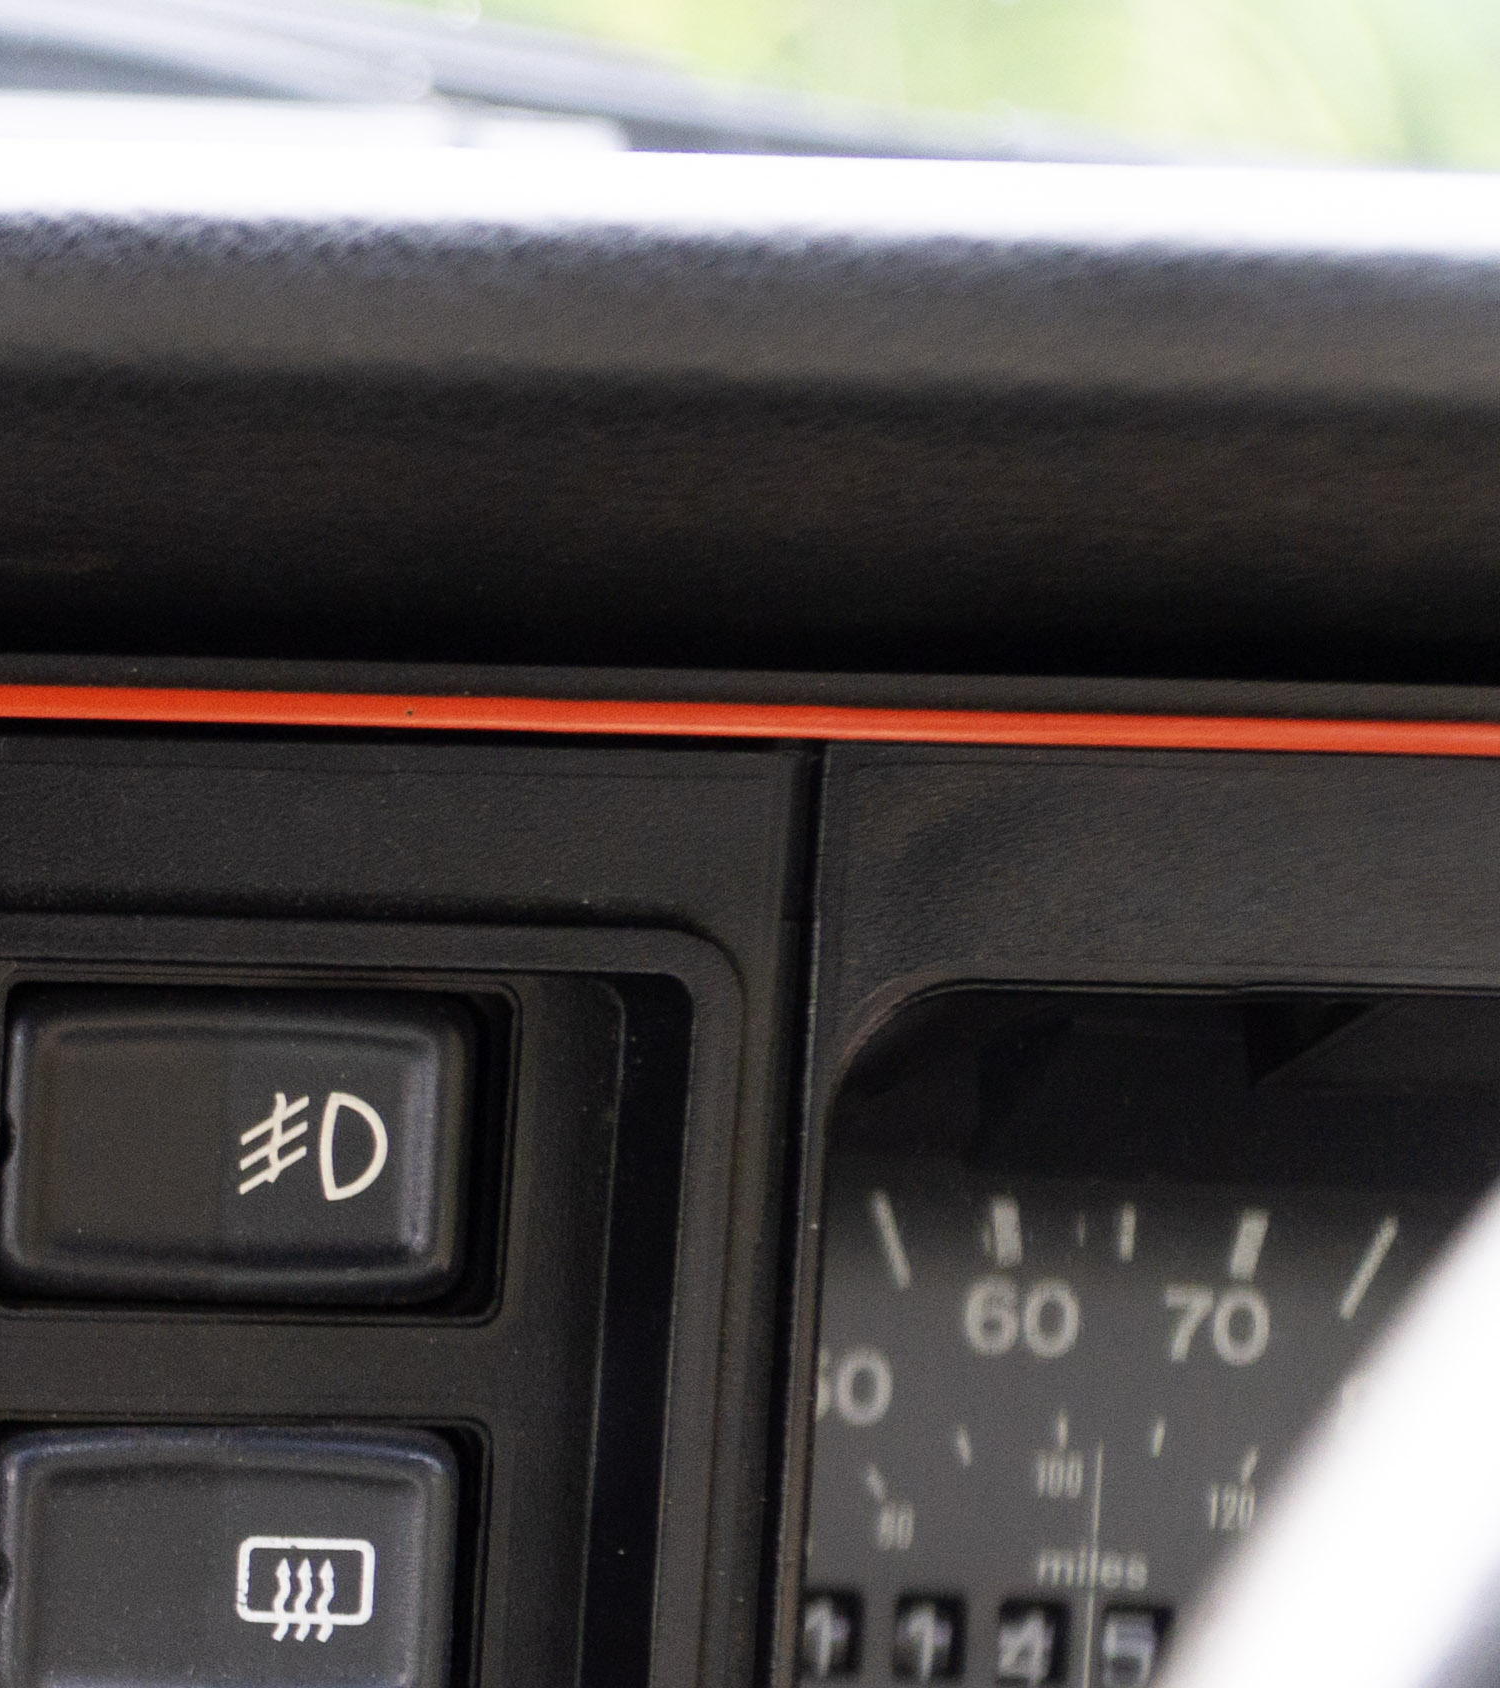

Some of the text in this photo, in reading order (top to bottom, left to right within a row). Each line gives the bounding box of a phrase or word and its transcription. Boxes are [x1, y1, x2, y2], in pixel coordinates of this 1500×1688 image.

[964, 1273, 1081, 1359] 60
[1163, 1282, 1271, 1367] 70
[1037, 1542, 1148, 1591] miles
